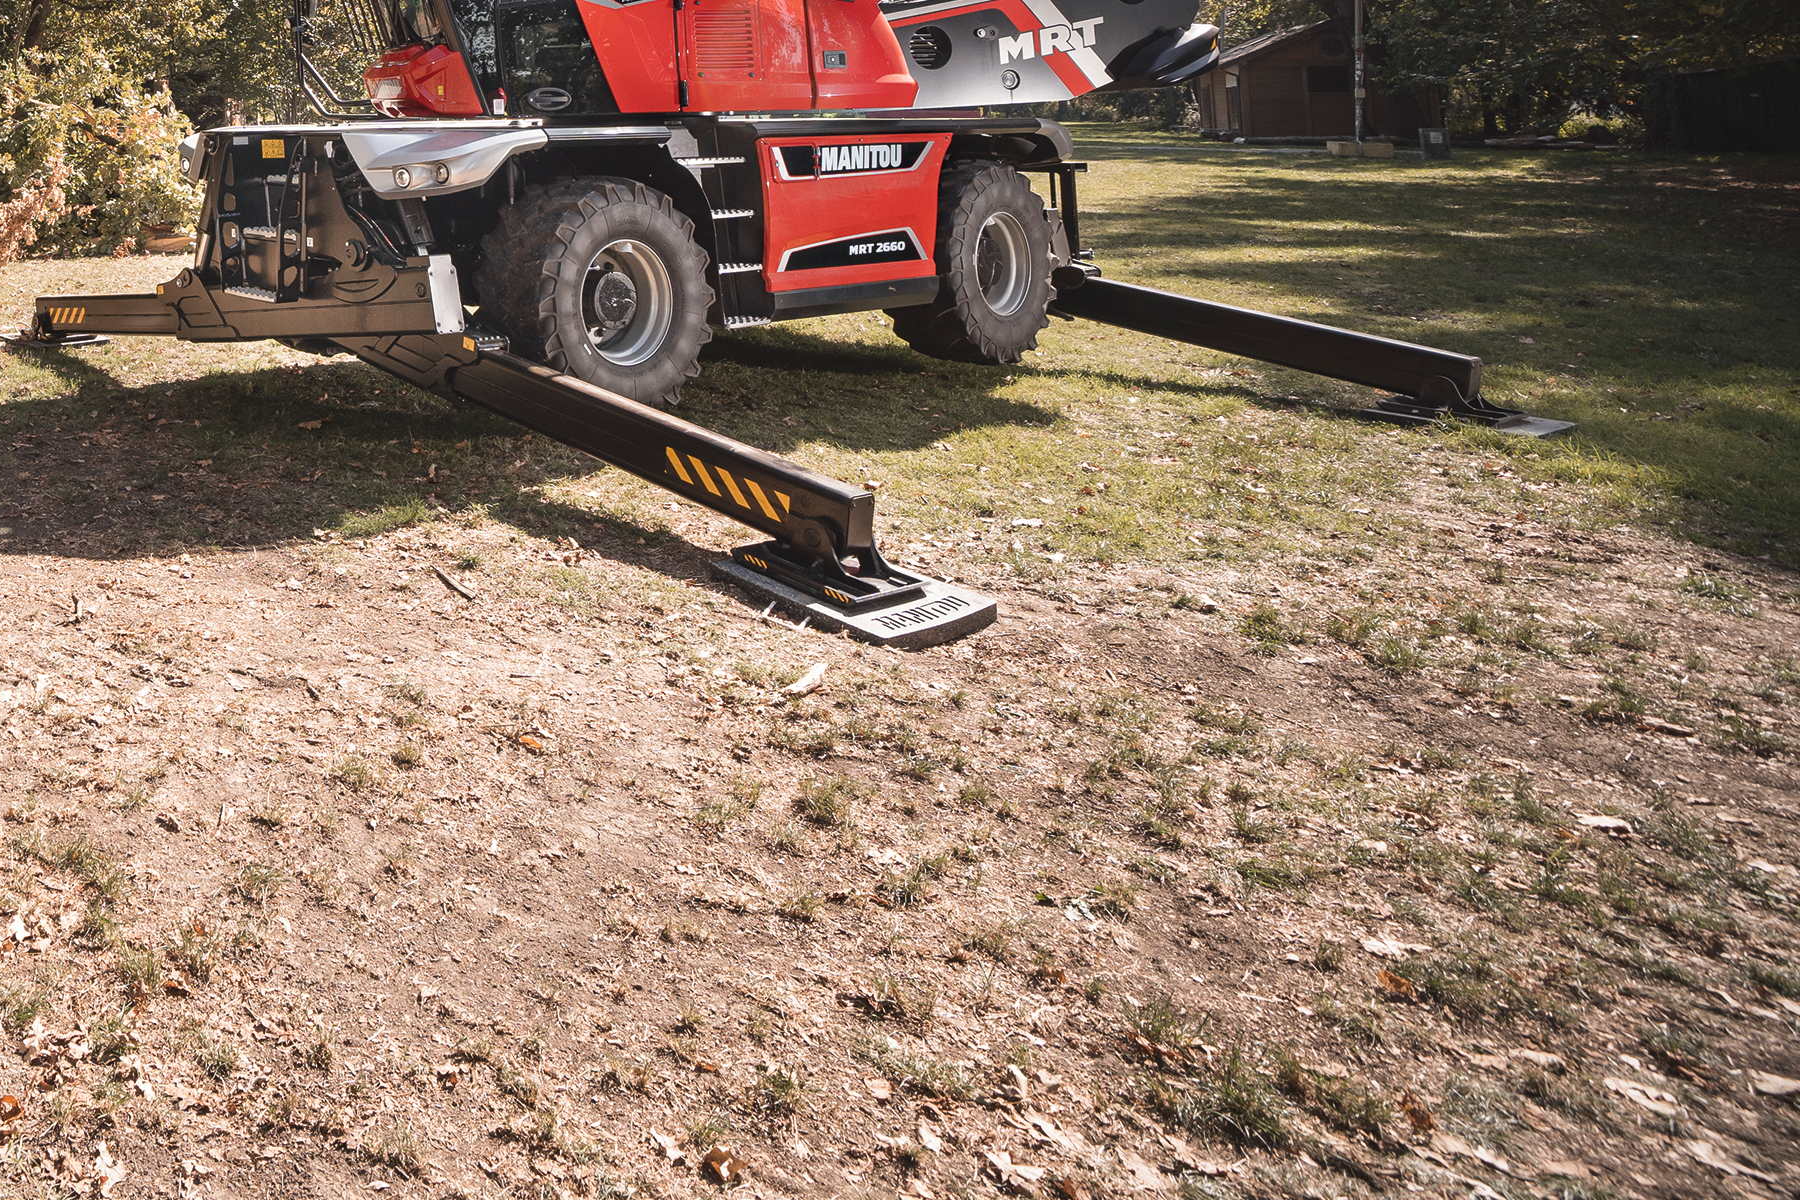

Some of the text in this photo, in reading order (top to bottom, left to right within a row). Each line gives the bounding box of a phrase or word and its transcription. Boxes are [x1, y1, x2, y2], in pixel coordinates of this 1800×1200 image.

[998, 15, 1104, 65] MRT
[821, 144, 902, 172] MANITOU
[848, 240, 906, 256] MRT 2660
